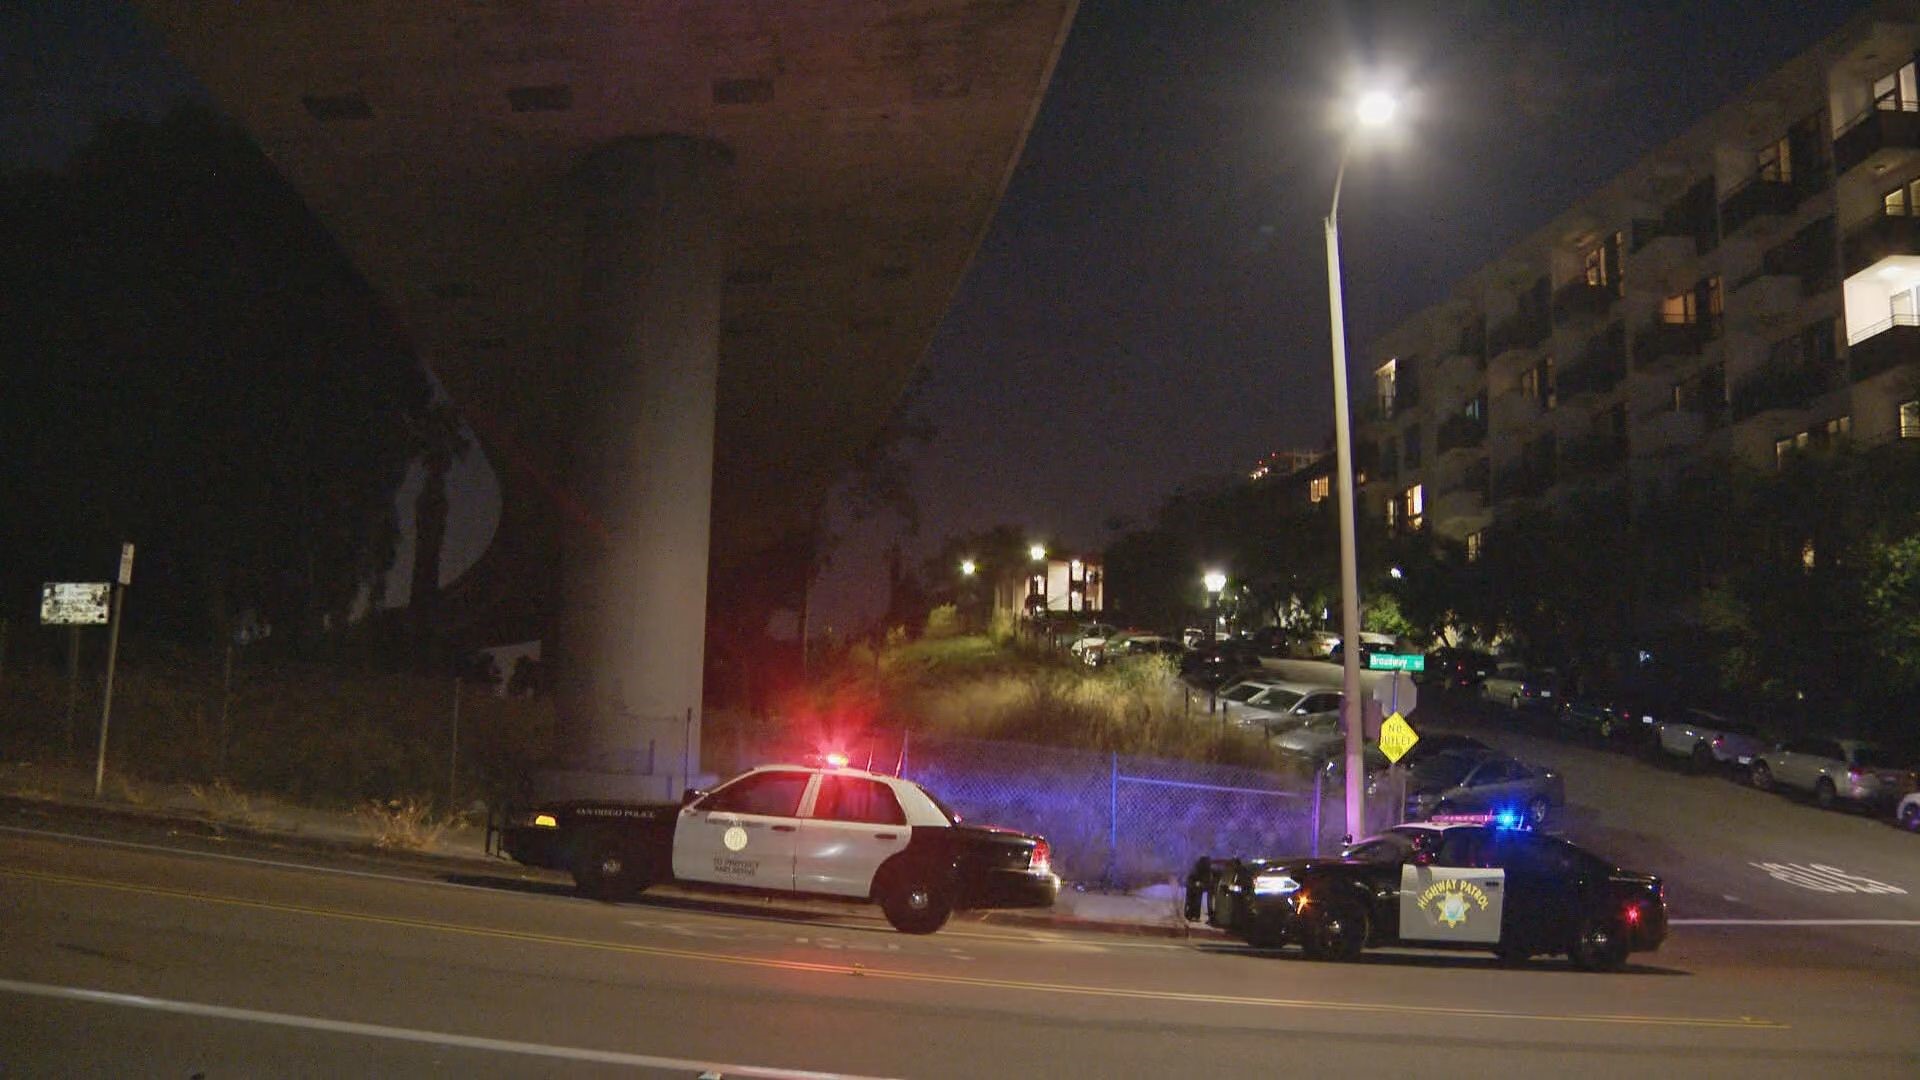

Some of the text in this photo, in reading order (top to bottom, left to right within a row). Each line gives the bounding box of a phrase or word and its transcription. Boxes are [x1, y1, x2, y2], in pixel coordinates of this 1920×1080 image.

[1389, 725, 1402, 733] NO
[1417, 878, 1490, 912] HIGHWAY PATROL
